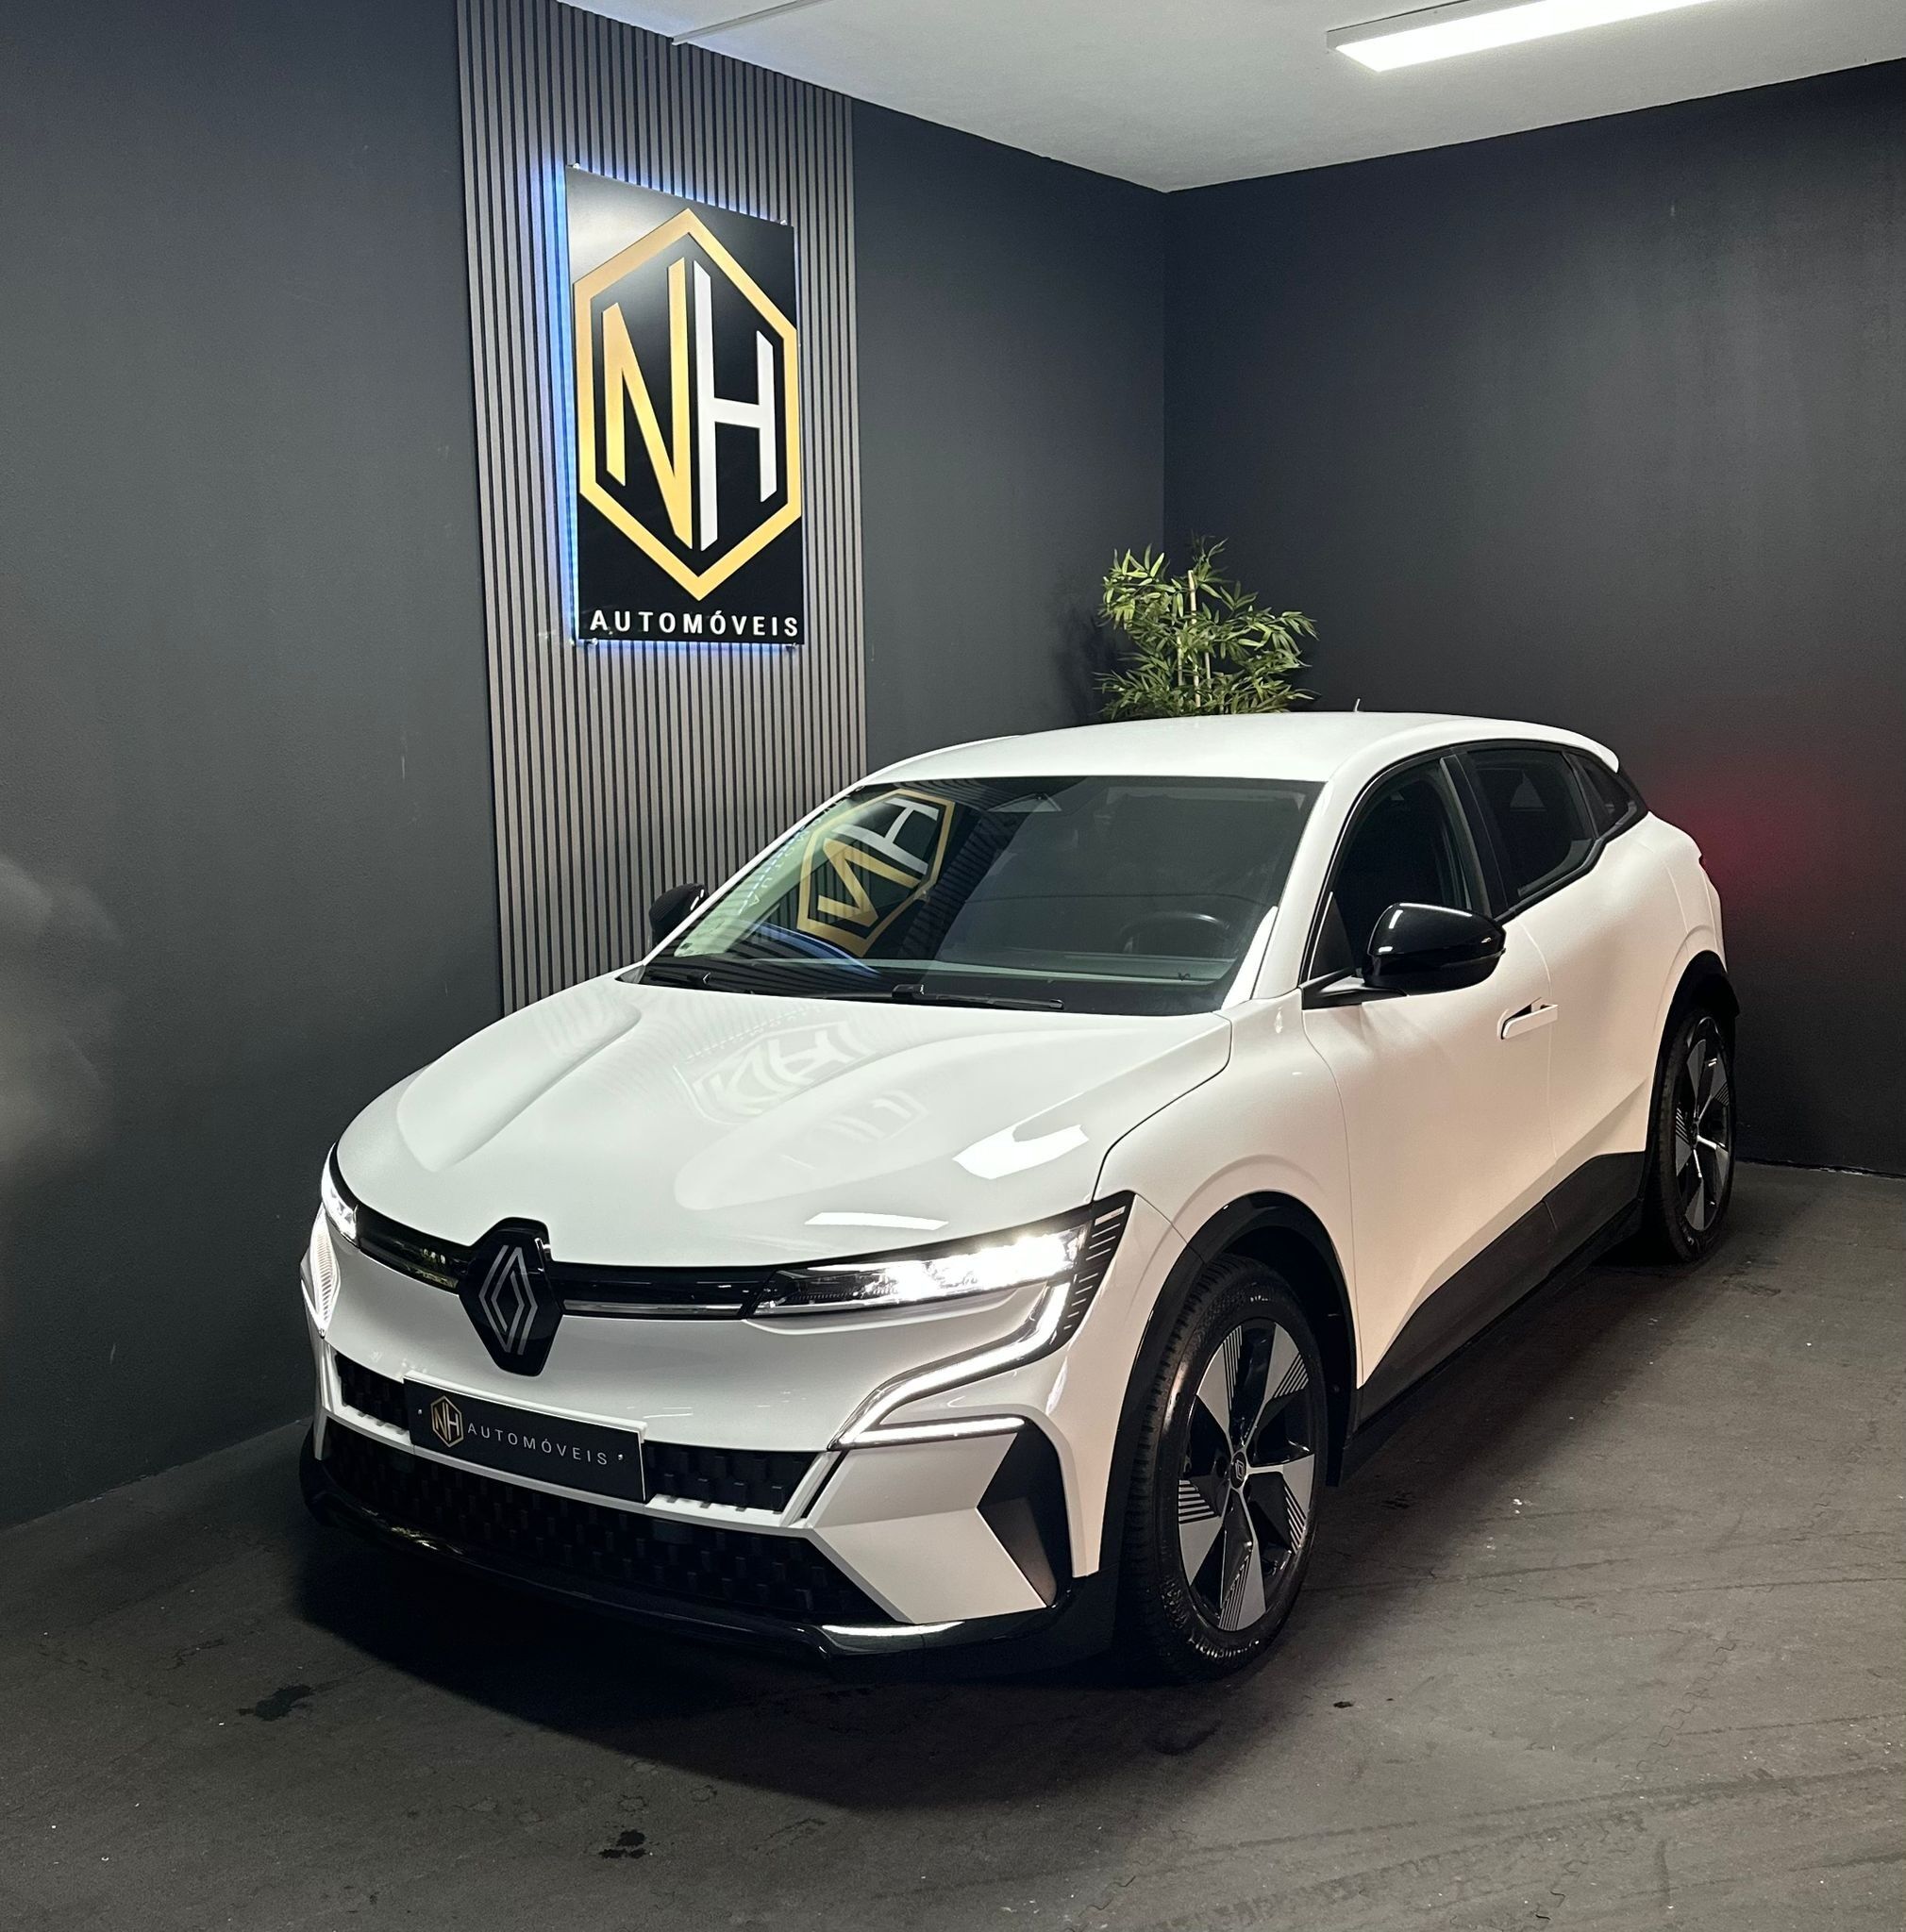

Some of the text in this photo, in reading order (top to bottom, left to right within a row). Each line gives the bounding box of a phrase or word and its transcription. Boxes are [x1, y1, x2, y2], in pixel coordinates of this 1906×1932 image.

[602, 257, 777, 551] NH
[590, 609, 798, 637] AUTOMÓVEIS
[434, 1401, 609, 1465] NH AUTOMÓVEIS
